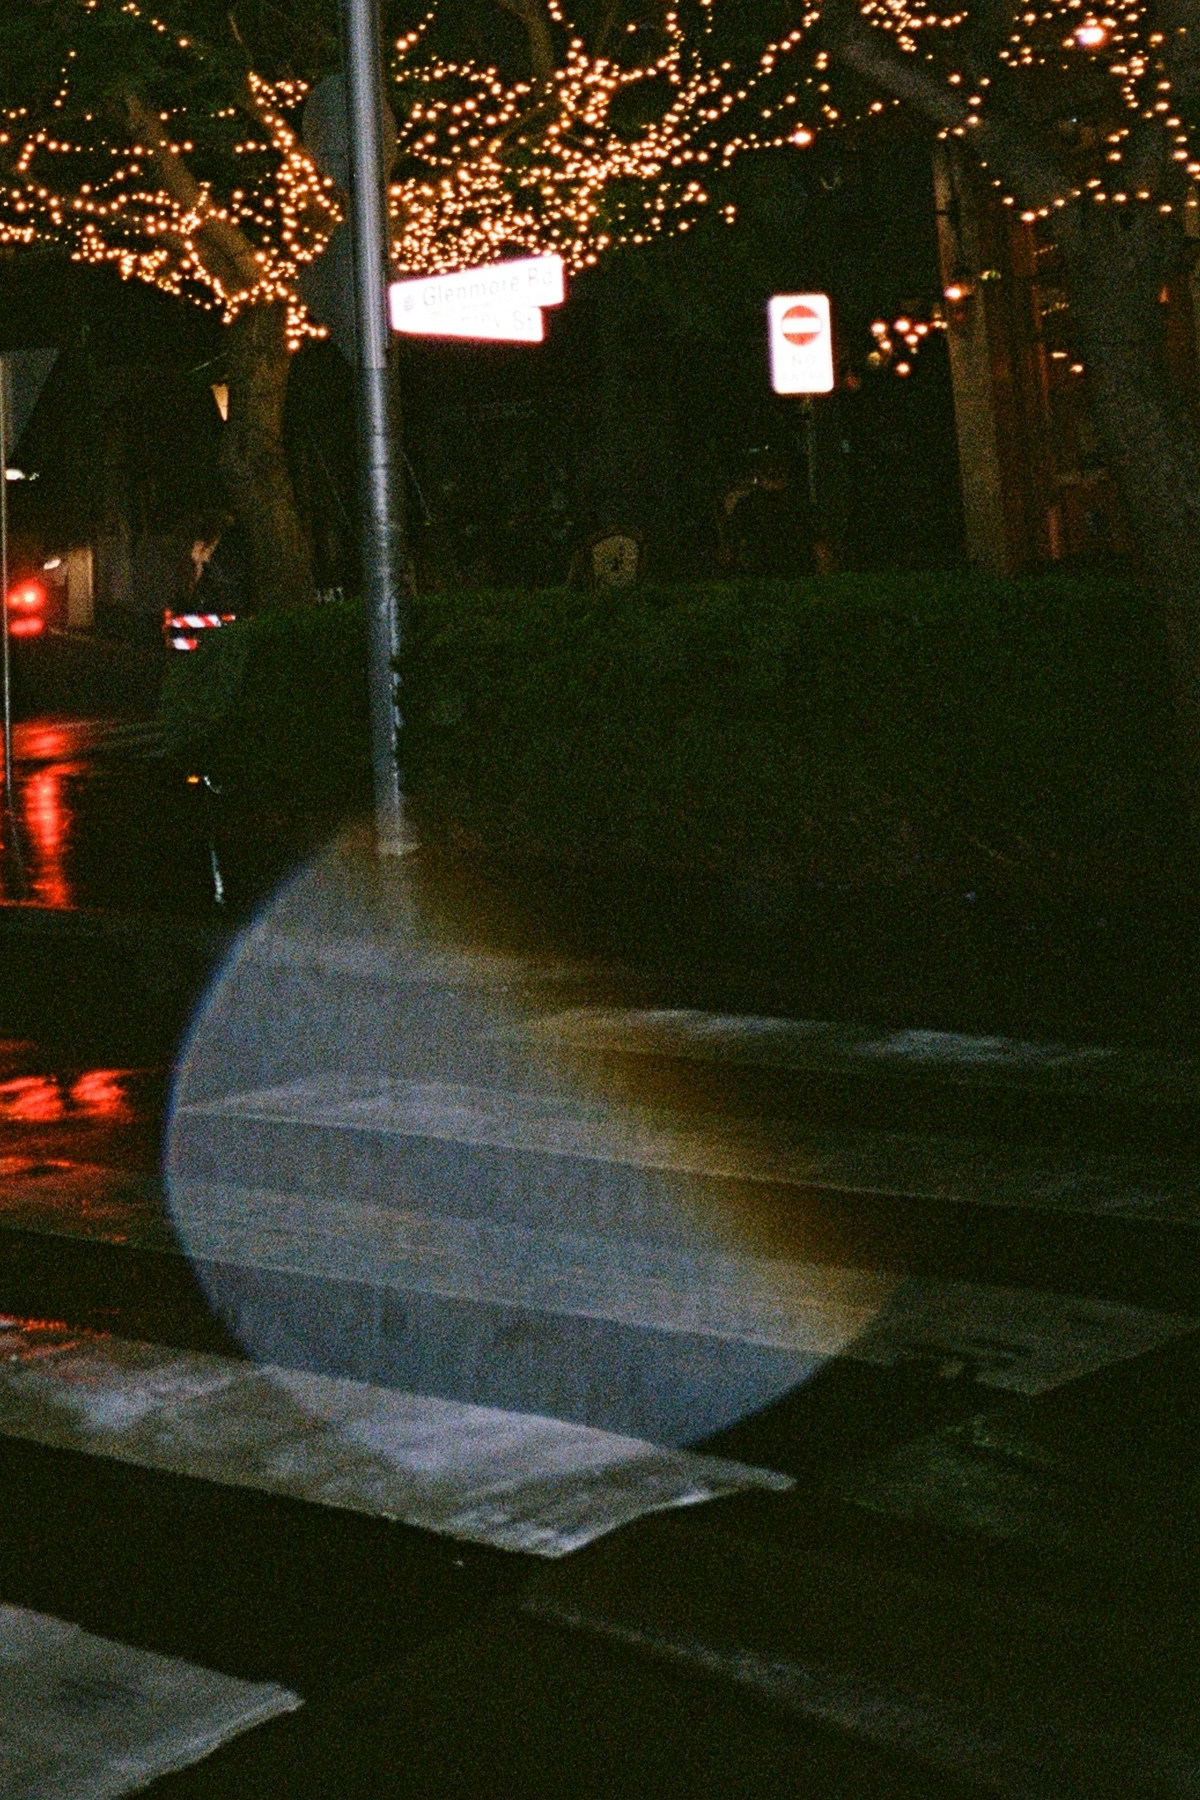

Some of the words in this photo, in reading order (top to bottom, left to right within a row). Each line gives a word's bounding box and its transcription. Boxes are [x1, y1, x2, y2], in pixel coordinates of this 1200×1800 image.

[423, 276, 519, 306] Glenmore
[528, 266, 553, 288] Rd
[791, 354, 816, 366] NO
